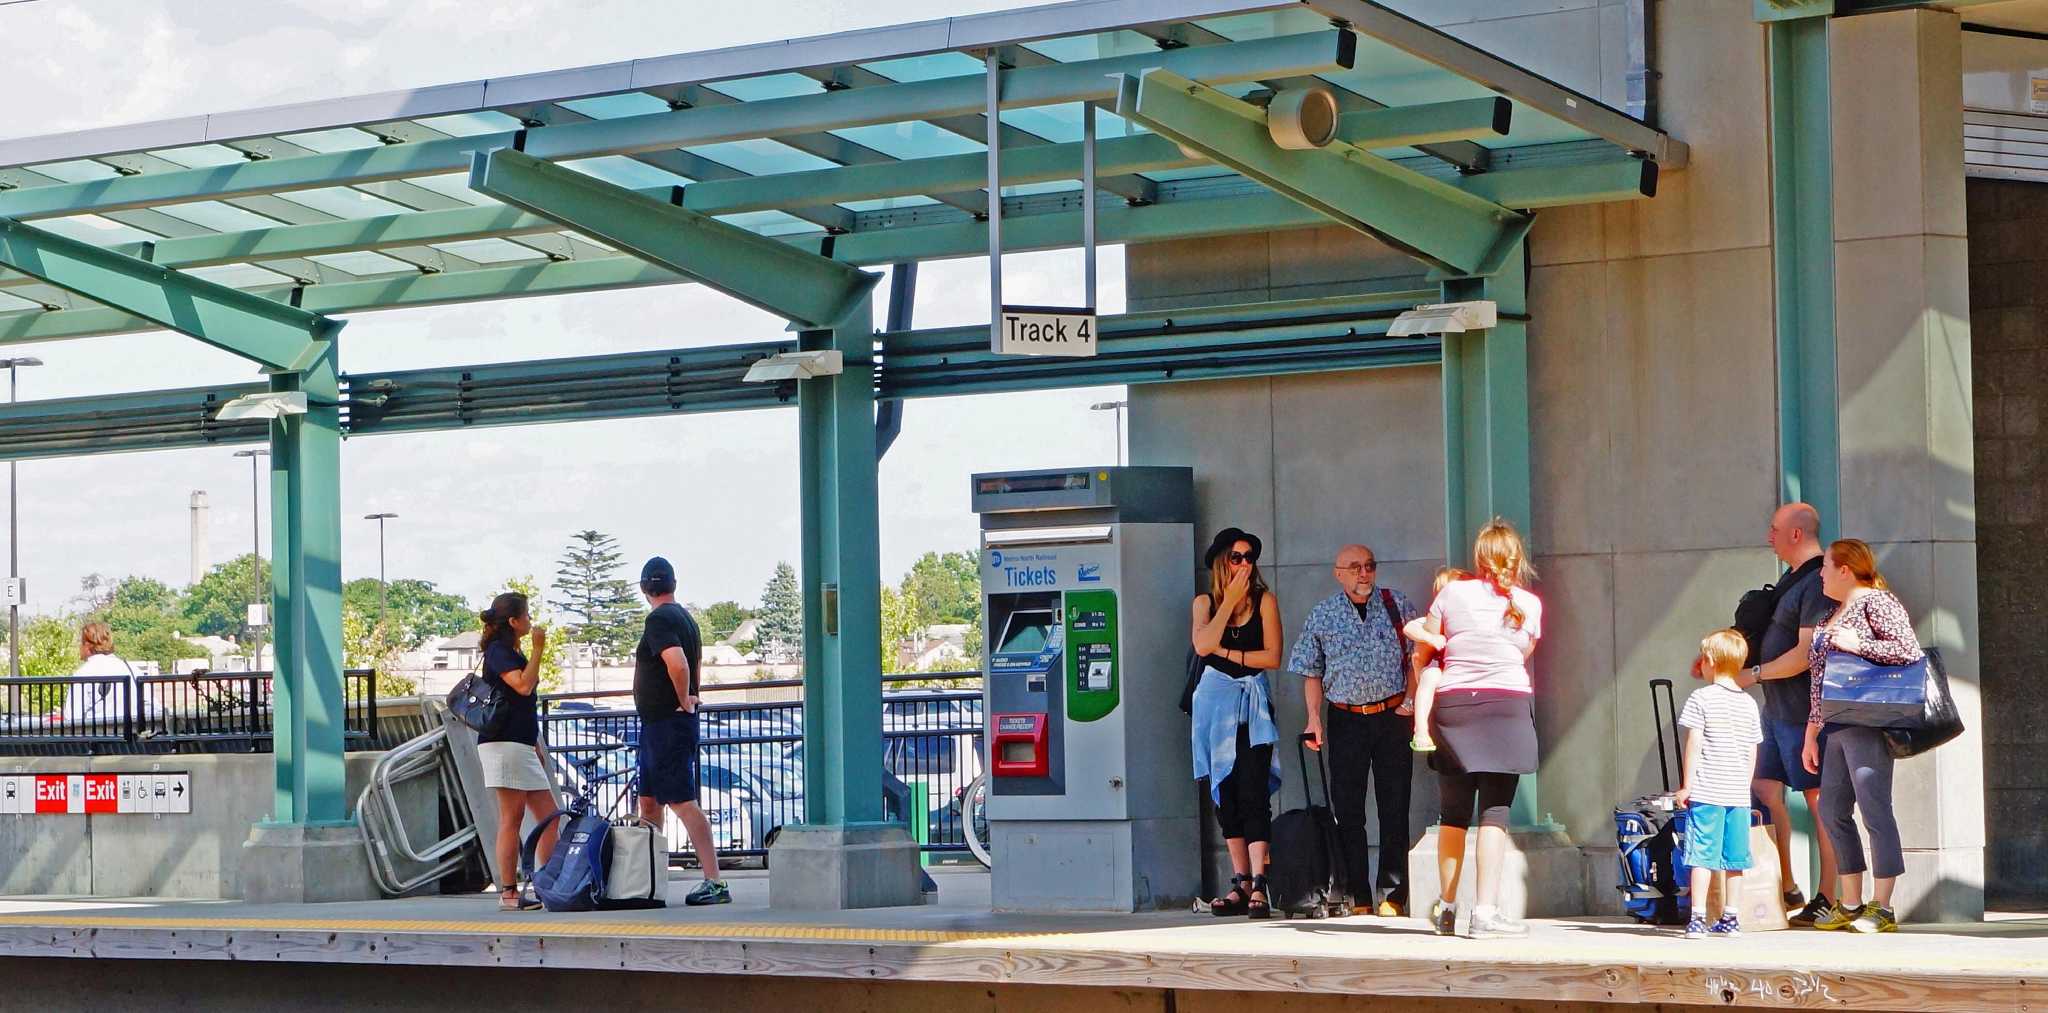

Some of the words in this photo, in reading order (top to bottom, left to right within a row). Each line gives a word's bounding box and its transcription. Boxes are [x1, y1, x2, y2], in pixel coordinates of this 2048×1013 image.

[1006, 316, 1068, 342] Track
[1077, 319, 1090, 343] 4
[1004, 566, 1057, 587] Tickets
[36, 780, 66, 800] Exit
[86, 780, 116, 800] Exit
